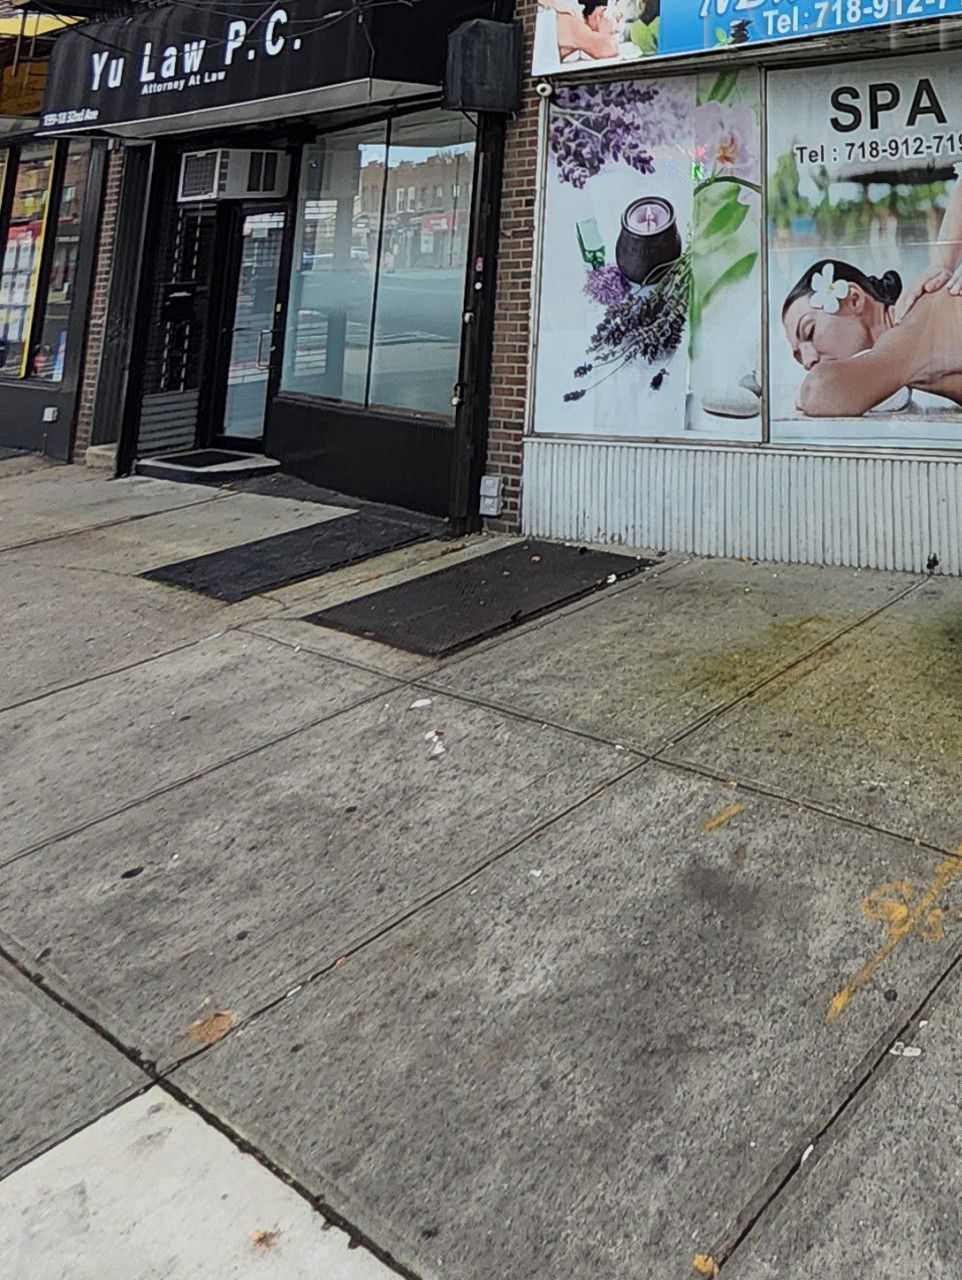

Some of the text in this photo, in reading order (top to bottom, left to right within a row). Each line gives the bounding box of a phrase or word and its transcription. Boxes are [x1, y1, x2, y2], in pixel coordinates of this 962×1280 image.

[91, 8, 302, 91] Yu Law P.C.
[140, 70, 227, 96] Attorney At Law
[829, 77, 948, 133] SPA
